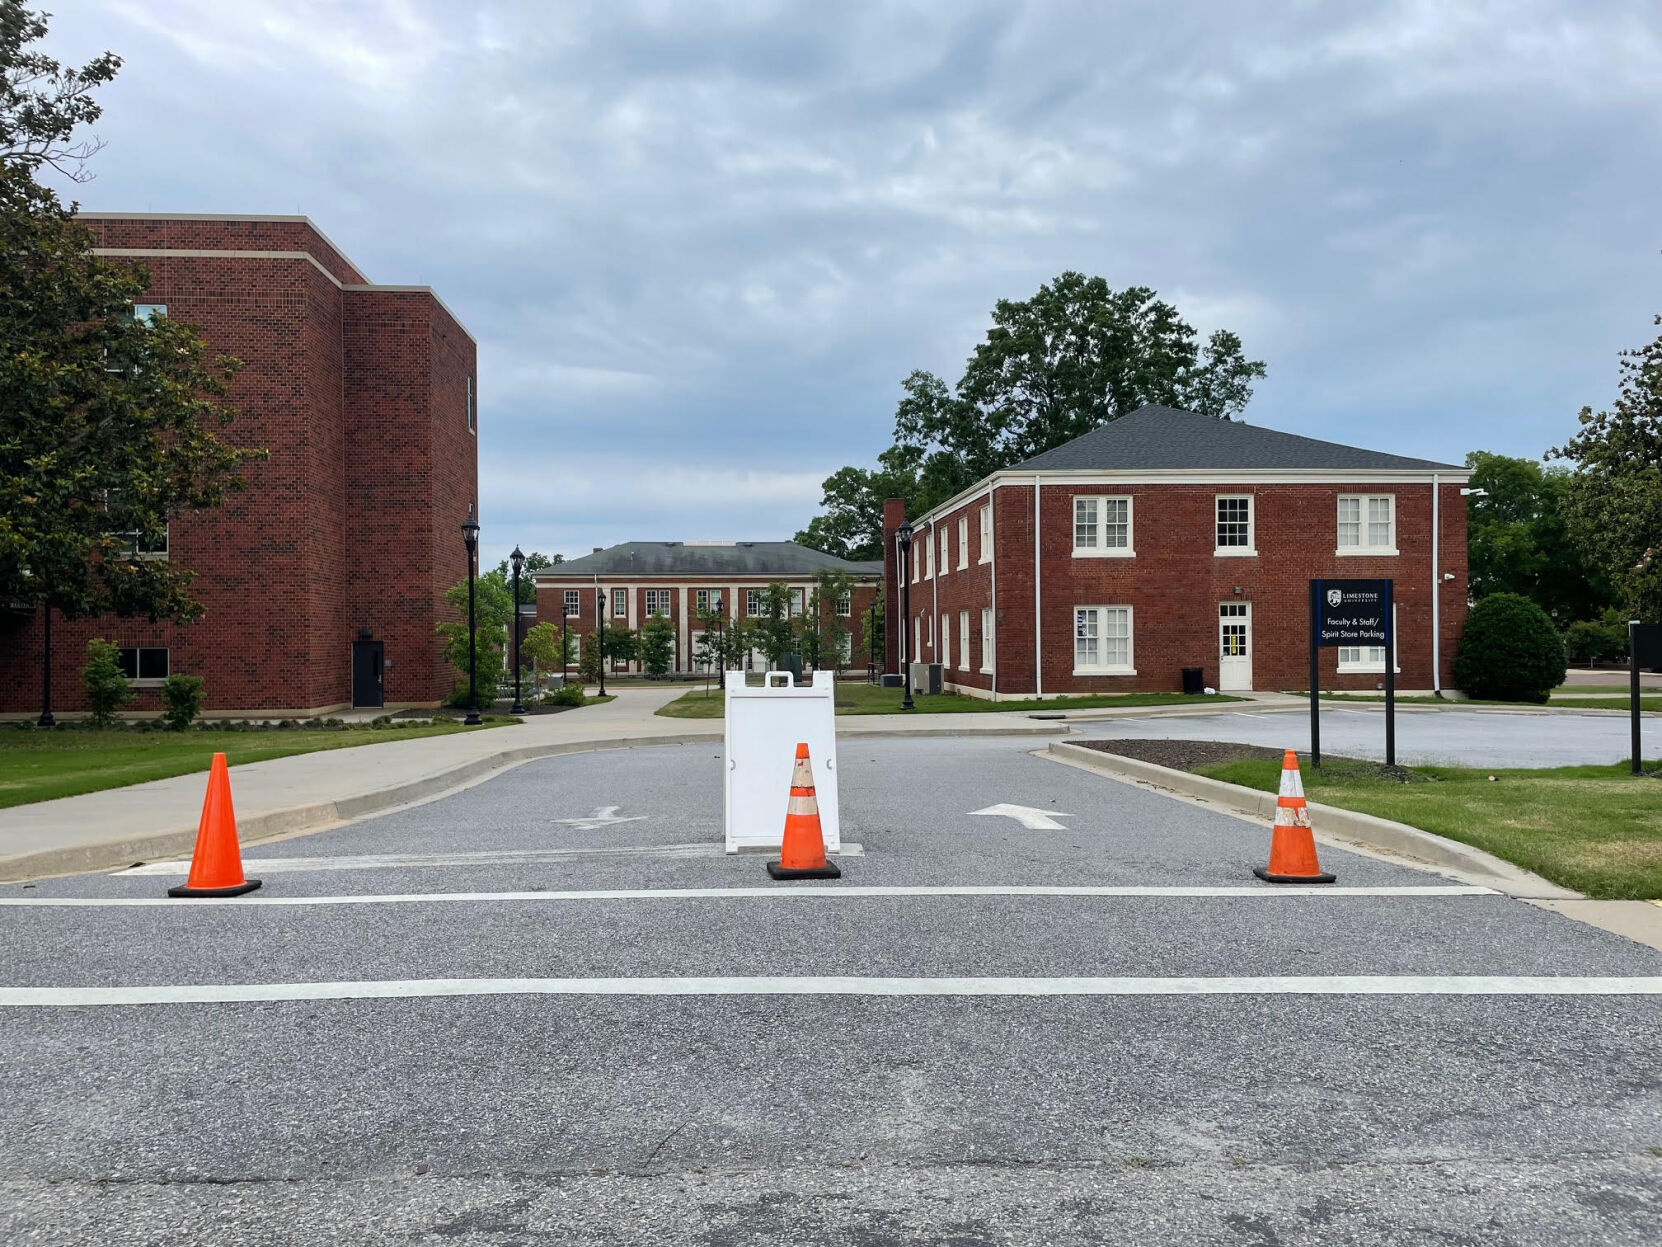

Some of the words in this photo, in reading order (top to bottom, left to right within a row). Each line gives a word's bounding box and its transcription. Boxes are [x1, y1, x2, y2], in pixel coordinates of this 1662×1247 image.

[1328, 618, 1350, 627] Faculty
[1359, 618, 1379, 627] Staff/
[1322, 630, 1339, 639] Spirit
[1360, 630, 1384, 639] Parking
